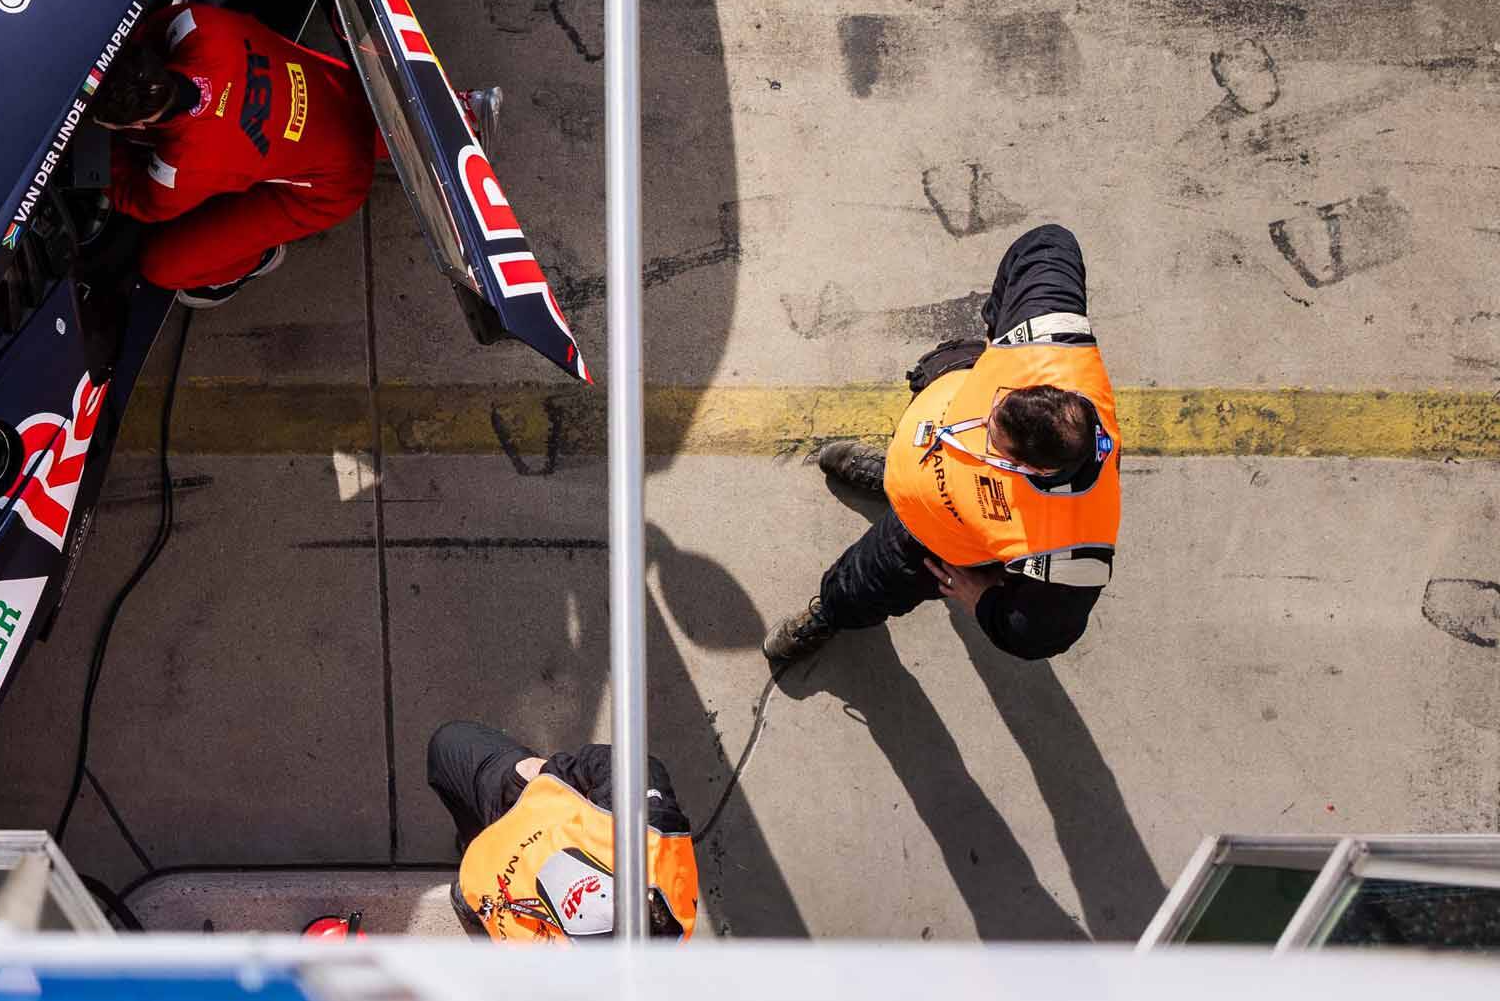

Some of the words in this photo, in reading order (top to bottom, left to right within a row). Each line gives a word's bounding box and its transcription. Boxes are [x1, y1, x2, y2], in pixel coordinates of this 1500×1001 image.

[95, 0, 143, 73] MAPELLI
[13, 185, 42, 225] VAN
[33, 149, 61, 190] DER
[52, 98, 87, 153] LINDE
[563, 878, 602, 921] 24h
